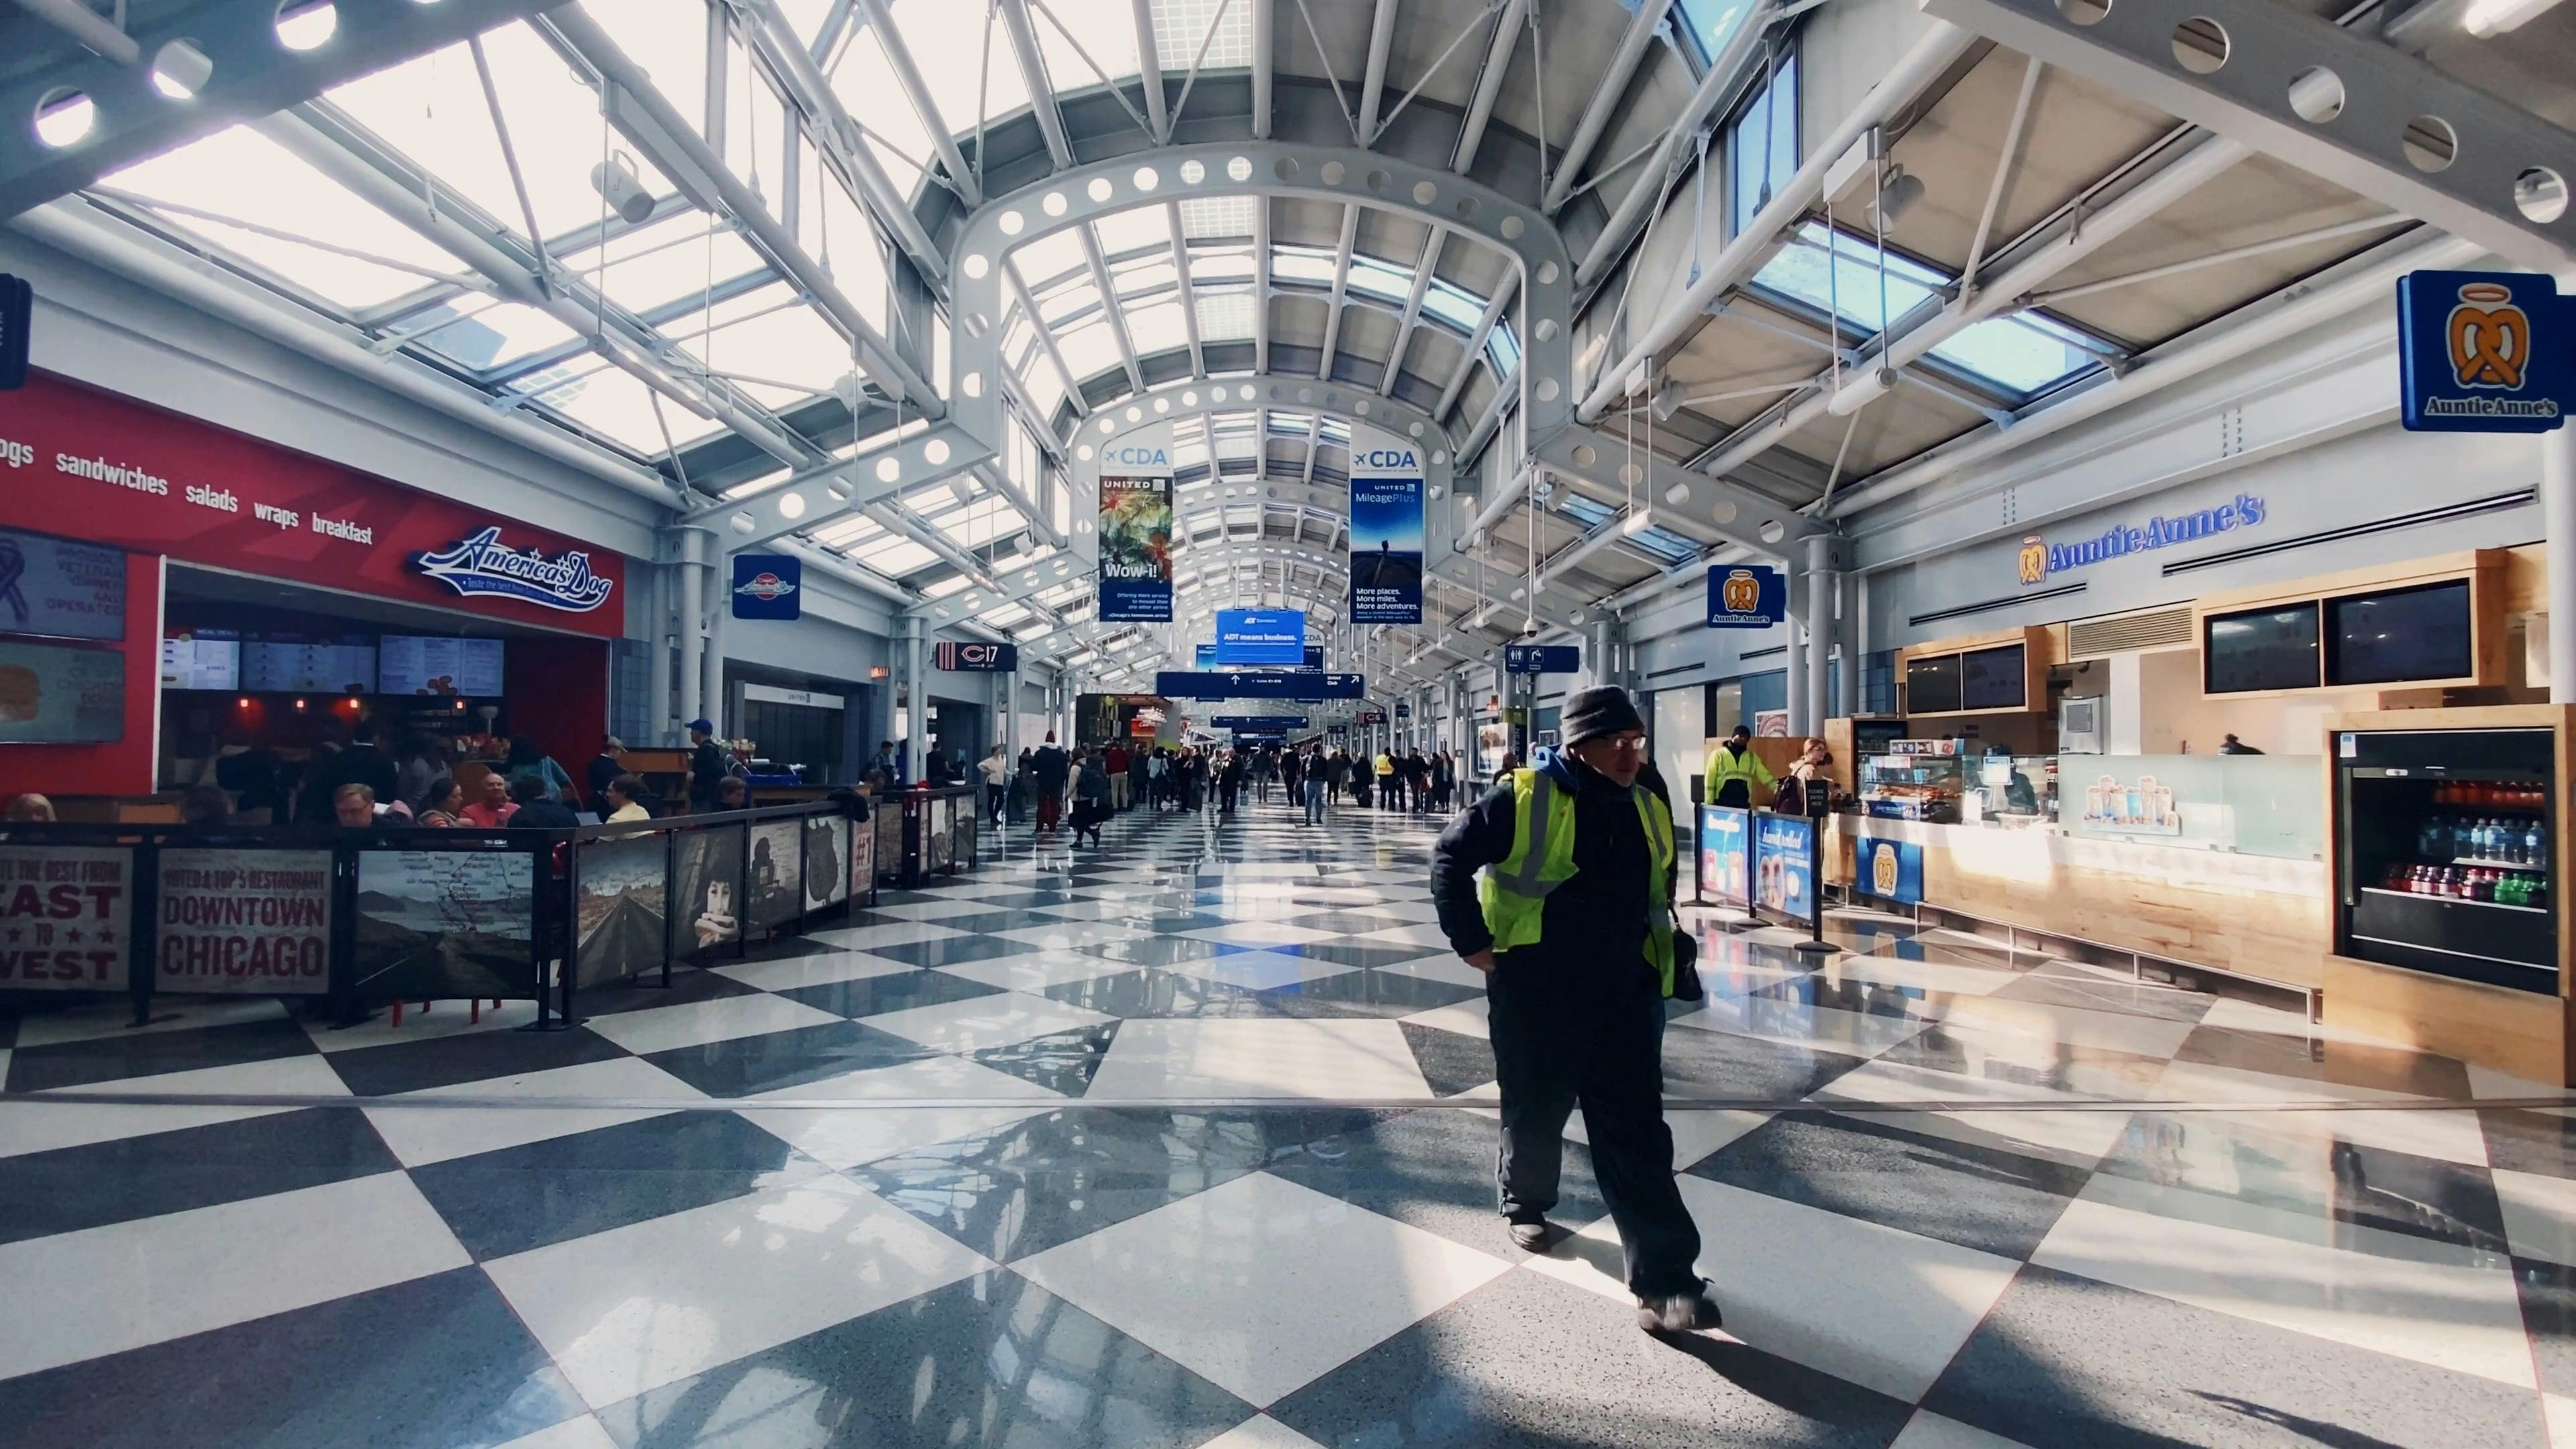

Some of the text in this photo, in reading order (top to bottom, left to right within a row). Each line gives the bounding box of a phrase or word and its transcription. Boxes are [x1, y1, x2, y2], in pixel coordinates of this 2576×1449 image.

[1120, 447, 1168, 465] CDA
[1370, 450, 1417, 468] CDA
[1104, 480, 1150, 489] UNITED
[56, 453, 168, 495] sandwiches
[186, 484, 238, 513] salads
[254, 502, 299, 530] wraps
[312, 512, 373, 545] breakfast
[1356, 493, 1415, 504] MileagePlus
[556, 551, 613, 598] Dog
[1105, 564, 1157, 578] Wow-i!
[1264, 633, 1297, 641] business.
[961, 645, 999, 662] C17
[857, 835, 871, 867] #1
[46, 860, 79, 882] BEST
[249, 871, 325, 890] RESTAURANT
[163, 896, 325, 926] DOWNTOWN
[36, 923, 54, 946] TO
[162, 934, 325, 976] CHICAGO
